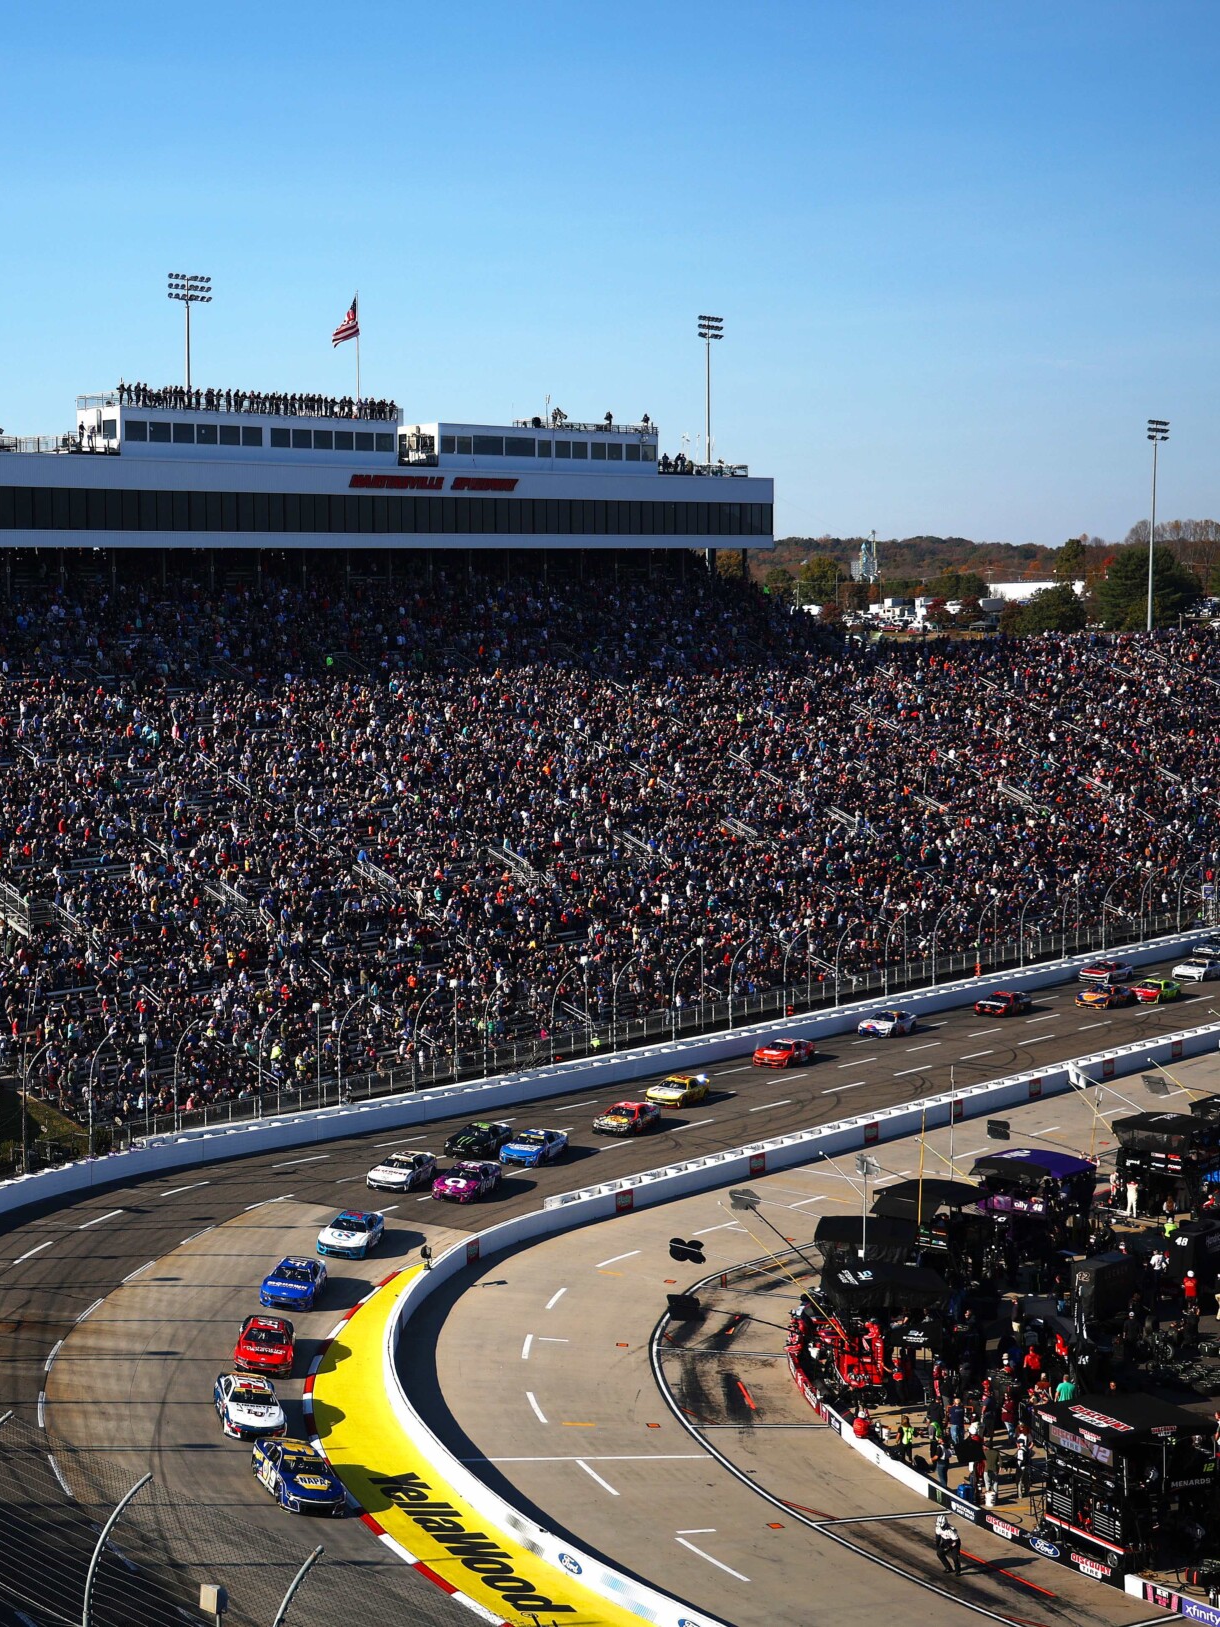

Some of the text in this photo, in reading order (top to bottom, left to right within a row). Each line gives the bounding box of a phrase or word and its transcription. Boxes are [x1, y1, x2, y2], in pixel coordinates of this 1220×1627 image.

[1014, 1201, 1043, 1211] ally 48
[1175, 1236, 1189, 1246] 48
[1068, 1405, 1134, 1432] DISCOUNT
[1077, 1413, 1106, 1427] TIRE
[1061, 1439, 1080, 1451] TIRE
[1092, 1444, 1111, 1463] 12
[1203, 1463, 1215, 1472] 12
[299, 1476, 326, 1486] NAPA
[1170, 1478, 1211, 1488] MENARDS
[985, 1515, 1020, 1537] DISCOUNT
[994, 1525, 1011, 1538] TIRE
[368, 1472, 577, 1612] YellaWood
[1033, 1539, 1056, 1556] Ford
[560, 1553, 580, 1573] Ford
[1070, 1552, 1112, 1576] DISCOUNT
[1081, 1564, 1100, 1577] TIRE
[1185, 1605, 1220, 1625] xfinity
